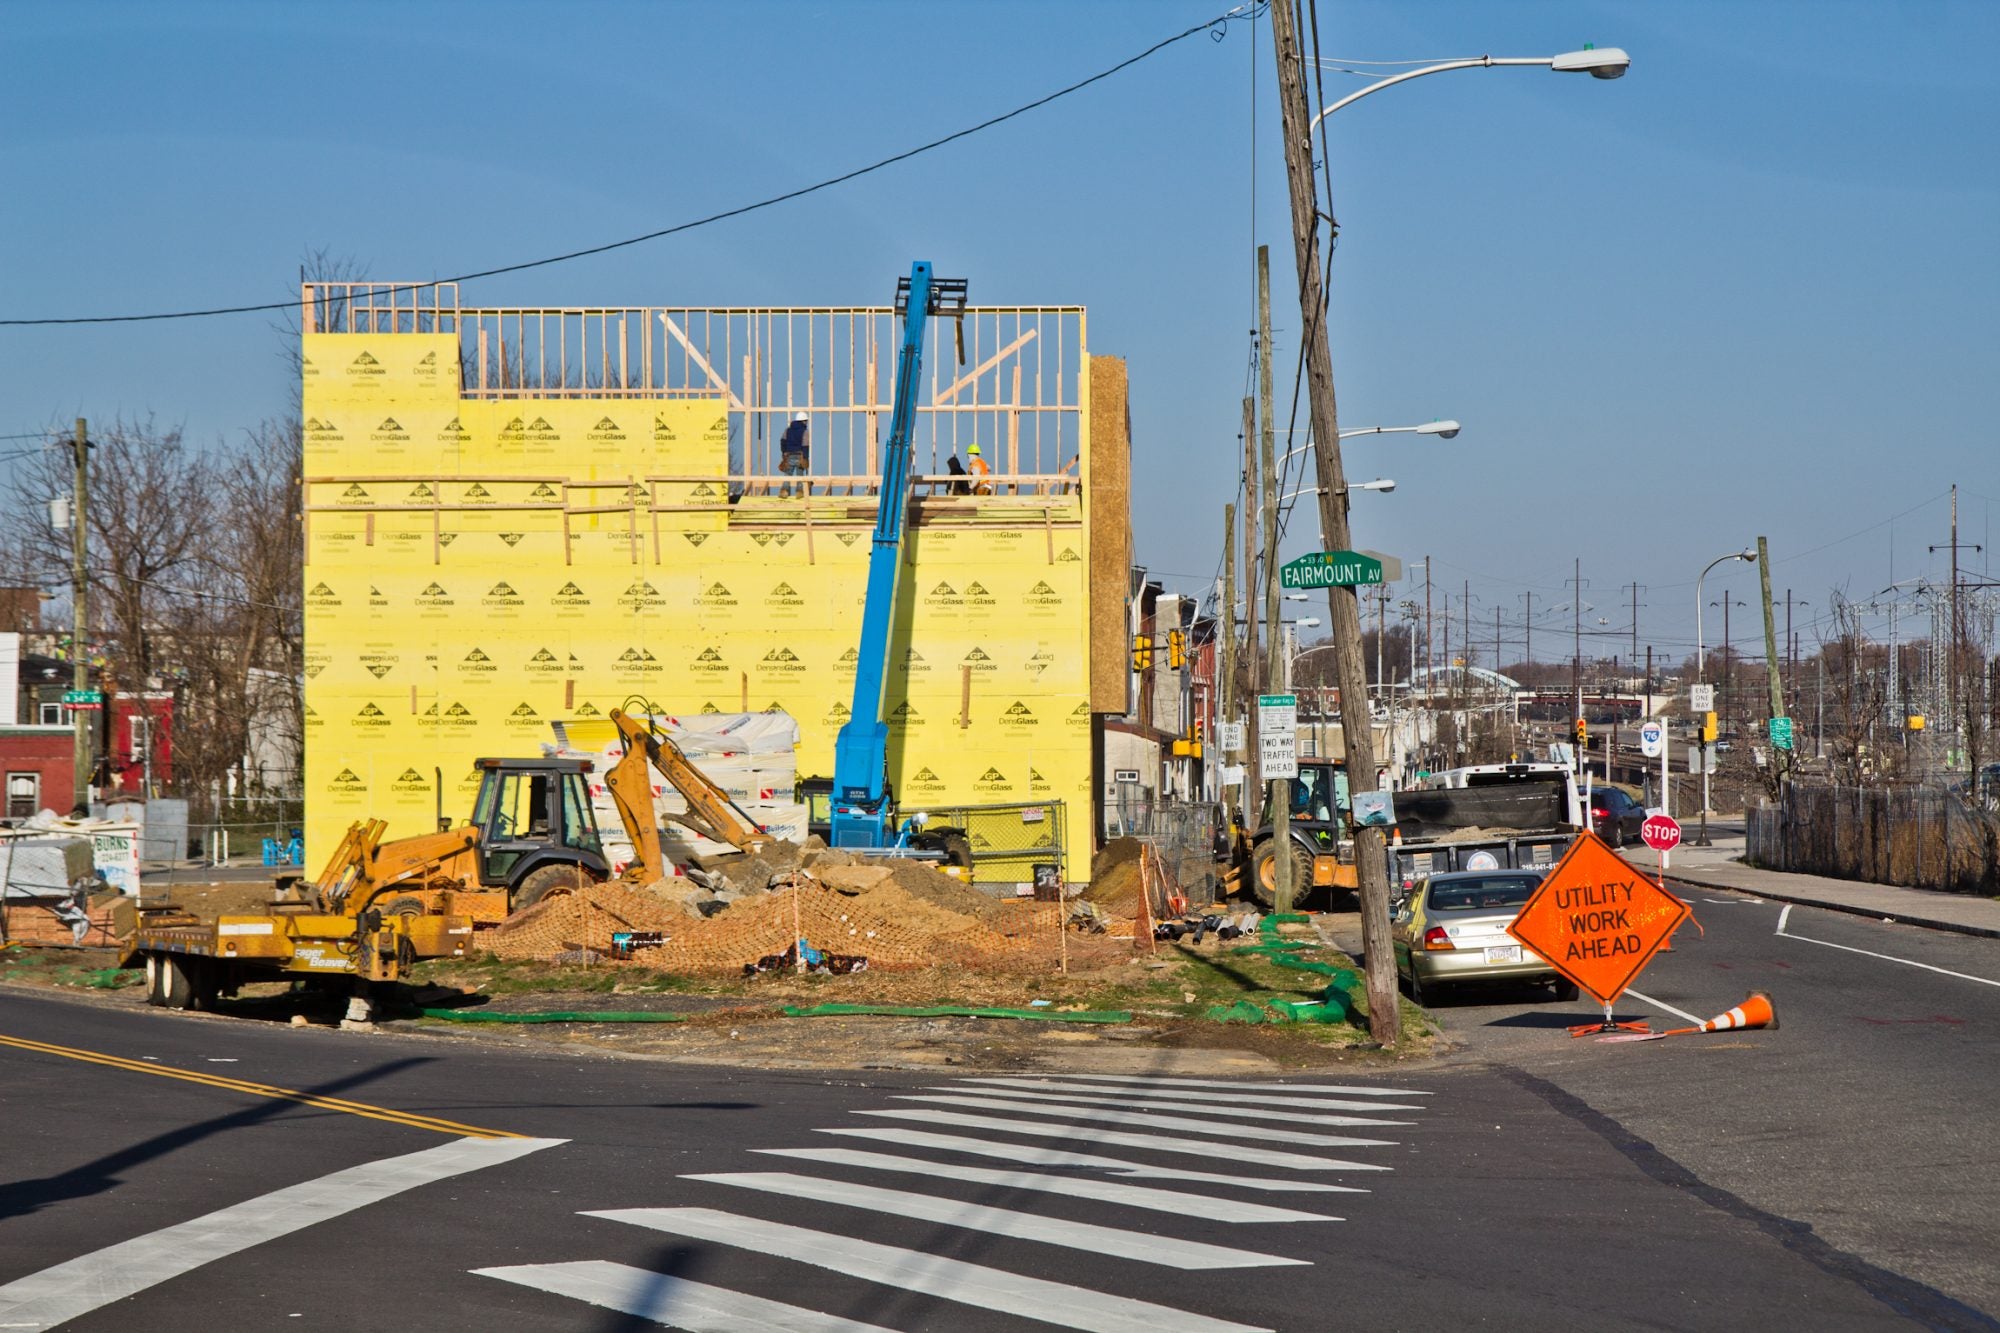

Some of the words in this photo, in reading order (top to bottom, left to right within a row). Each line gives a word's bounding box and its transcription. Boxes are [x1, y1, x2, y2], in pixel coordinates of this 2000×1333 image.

[1285, 564, 1362, 586] FAIRMOUNT
[1368, 569, 1380, 581] AV
[1261, 738, 1277, 747] TWO
[1280, 738, 1294, 746] WAY
[1645, 732, 1657, 740] 76
[1263, 750, 1294, 760] TRAFFIC
[1266, 763, 1293, 772] AHEAD
[1644, 825, 1679, 841] STOP
[96, 837, 128, 851] BURNS
[1555, 881, 1636, 910] UTILITY
[1570, 909, 1630, 934] WORK
[1566, 935, 1641, 962] AHEAD
